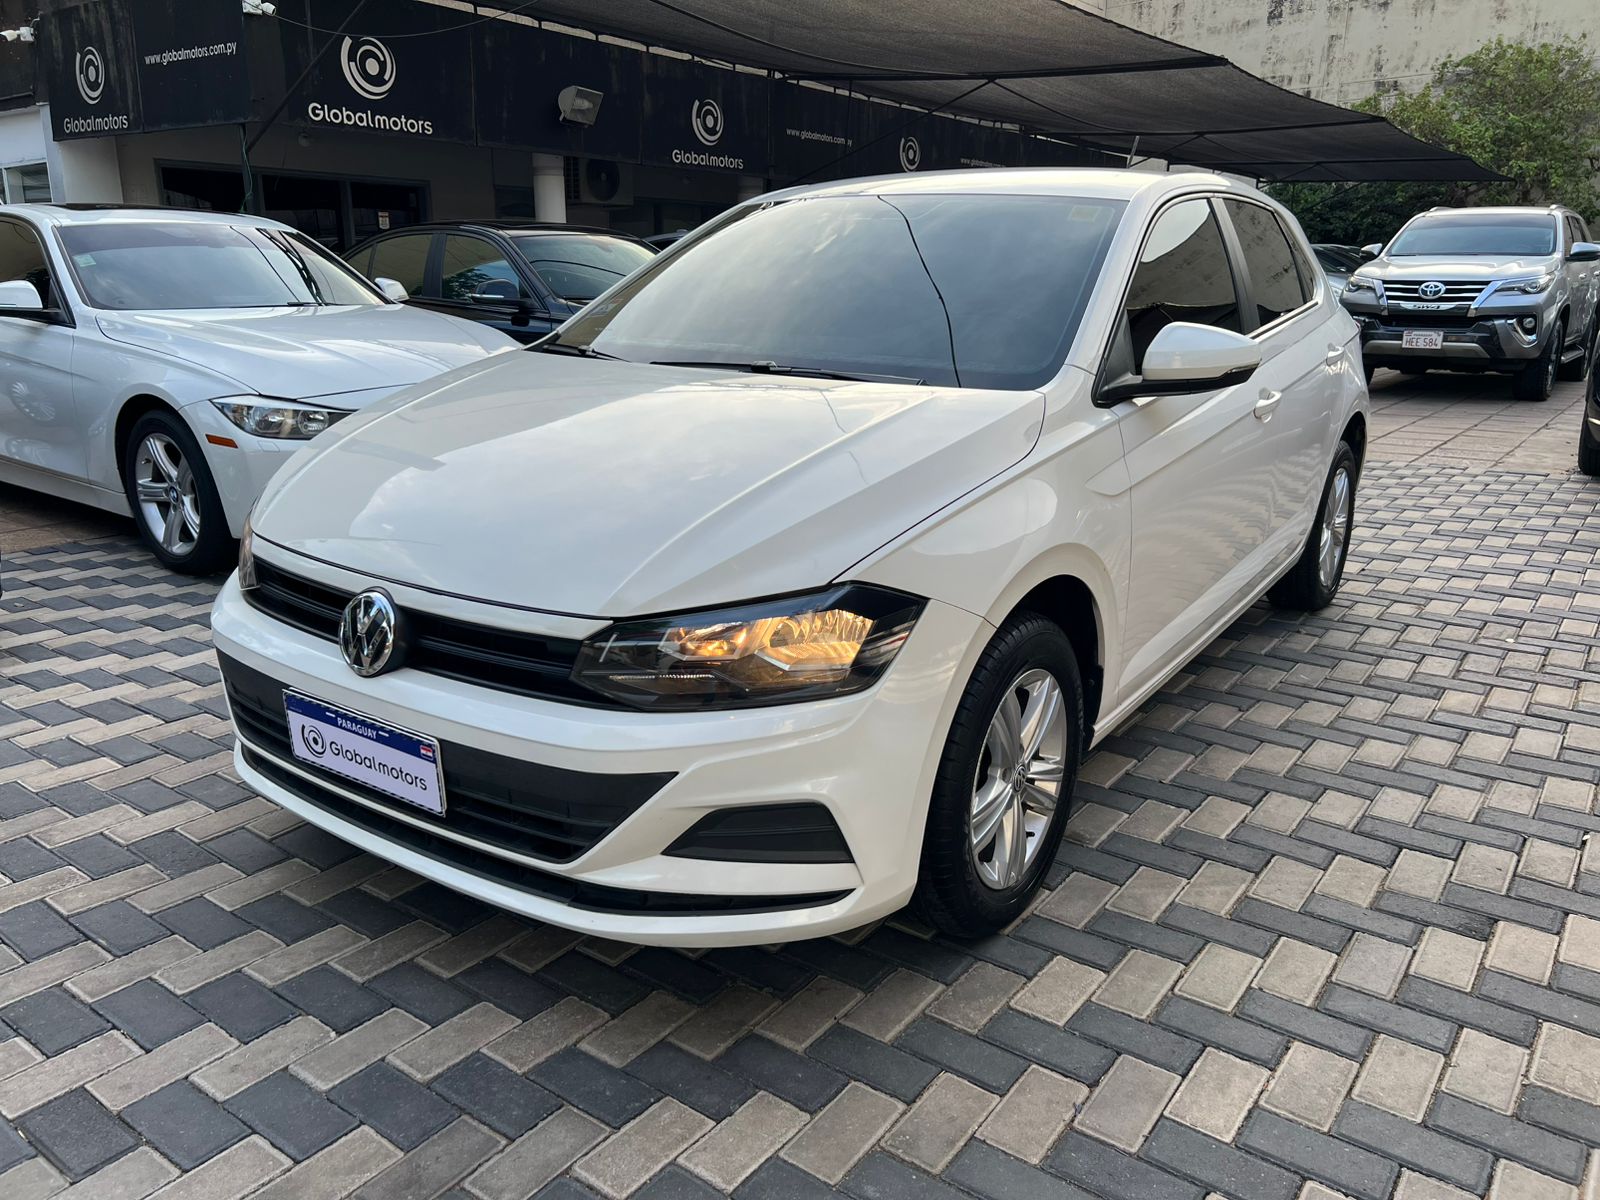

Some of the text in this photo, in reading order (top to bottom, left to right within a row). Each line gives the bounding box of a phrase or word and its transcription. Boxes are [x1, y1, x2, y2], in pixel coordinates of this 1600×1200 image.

[144, 42, 237, 66] www.globalmotors.com.py
[64, 113, 129, 134] Globalmotors
[308, 102, 433, 135] Globalmotors
[672, 149, 744, 170] Globalmotors
[1405, 337, 1422, 347] HEE
[336, 716, 377, 740] PARAGUAY
[329, 740, 428, 792] Globalmotors
